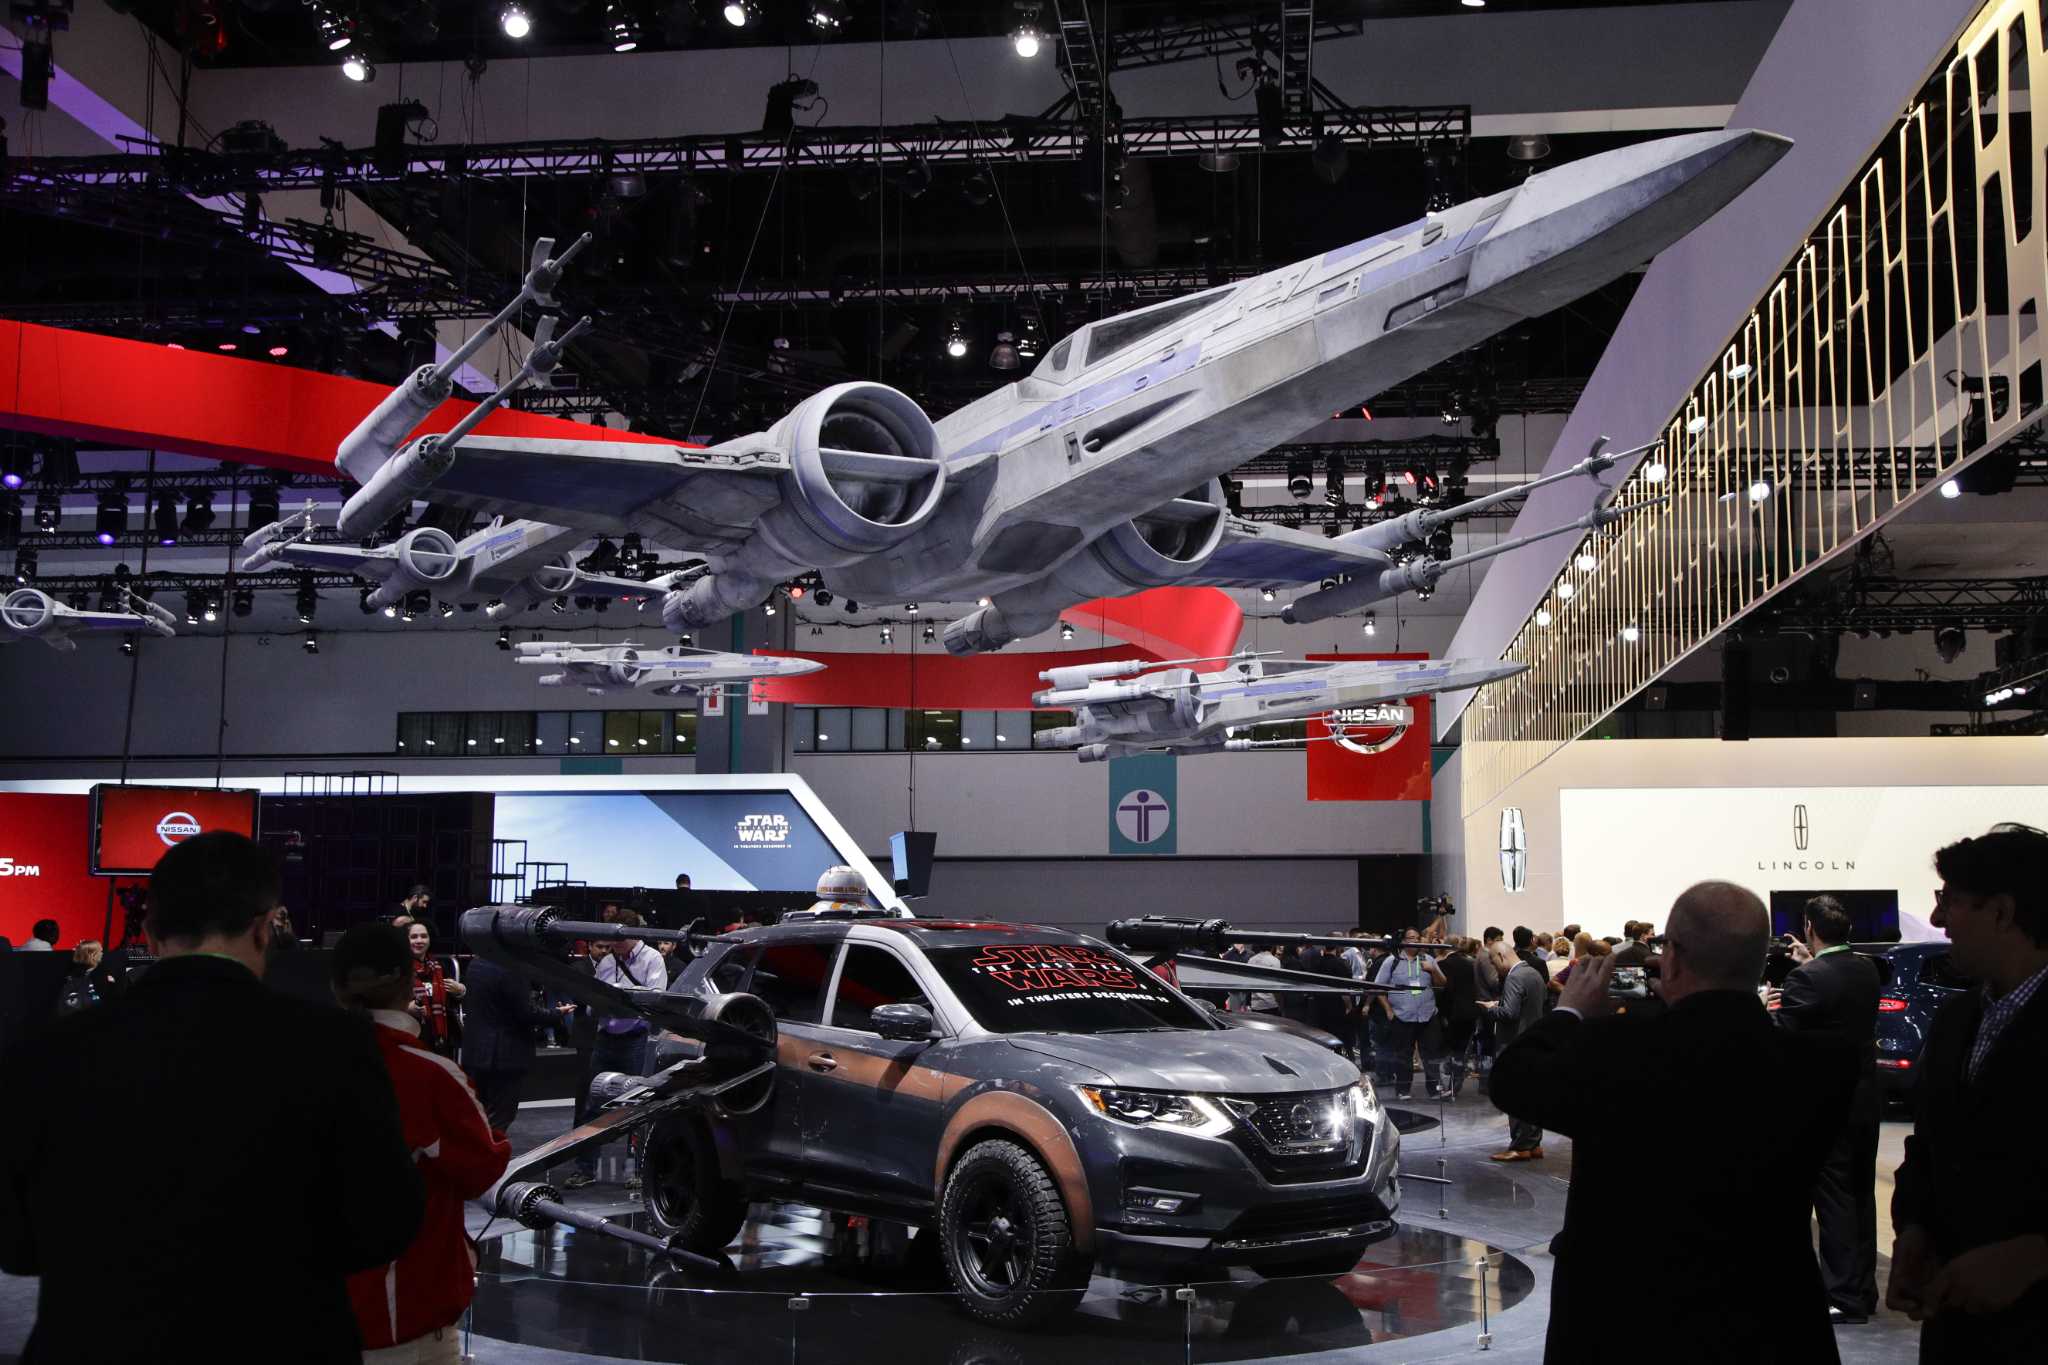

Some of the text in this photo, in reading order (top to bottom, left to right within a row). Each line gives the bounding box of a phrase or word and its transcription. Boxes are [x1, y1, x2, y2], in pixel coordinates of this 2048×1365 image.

[1334, 708, 1404, 721] NISSAN
[737, 815, 788, 826] STAR
[738, 830, 788, 841] WARS
[1757, 861, 1855, 870] LINCOLN
[973, 945, 1117, 966] STAR
[989, 969, 1137, 991] WARS
[1008, 998, 1024, 1006] IN
[1026, 992, 1091, 1003] THEATERS
